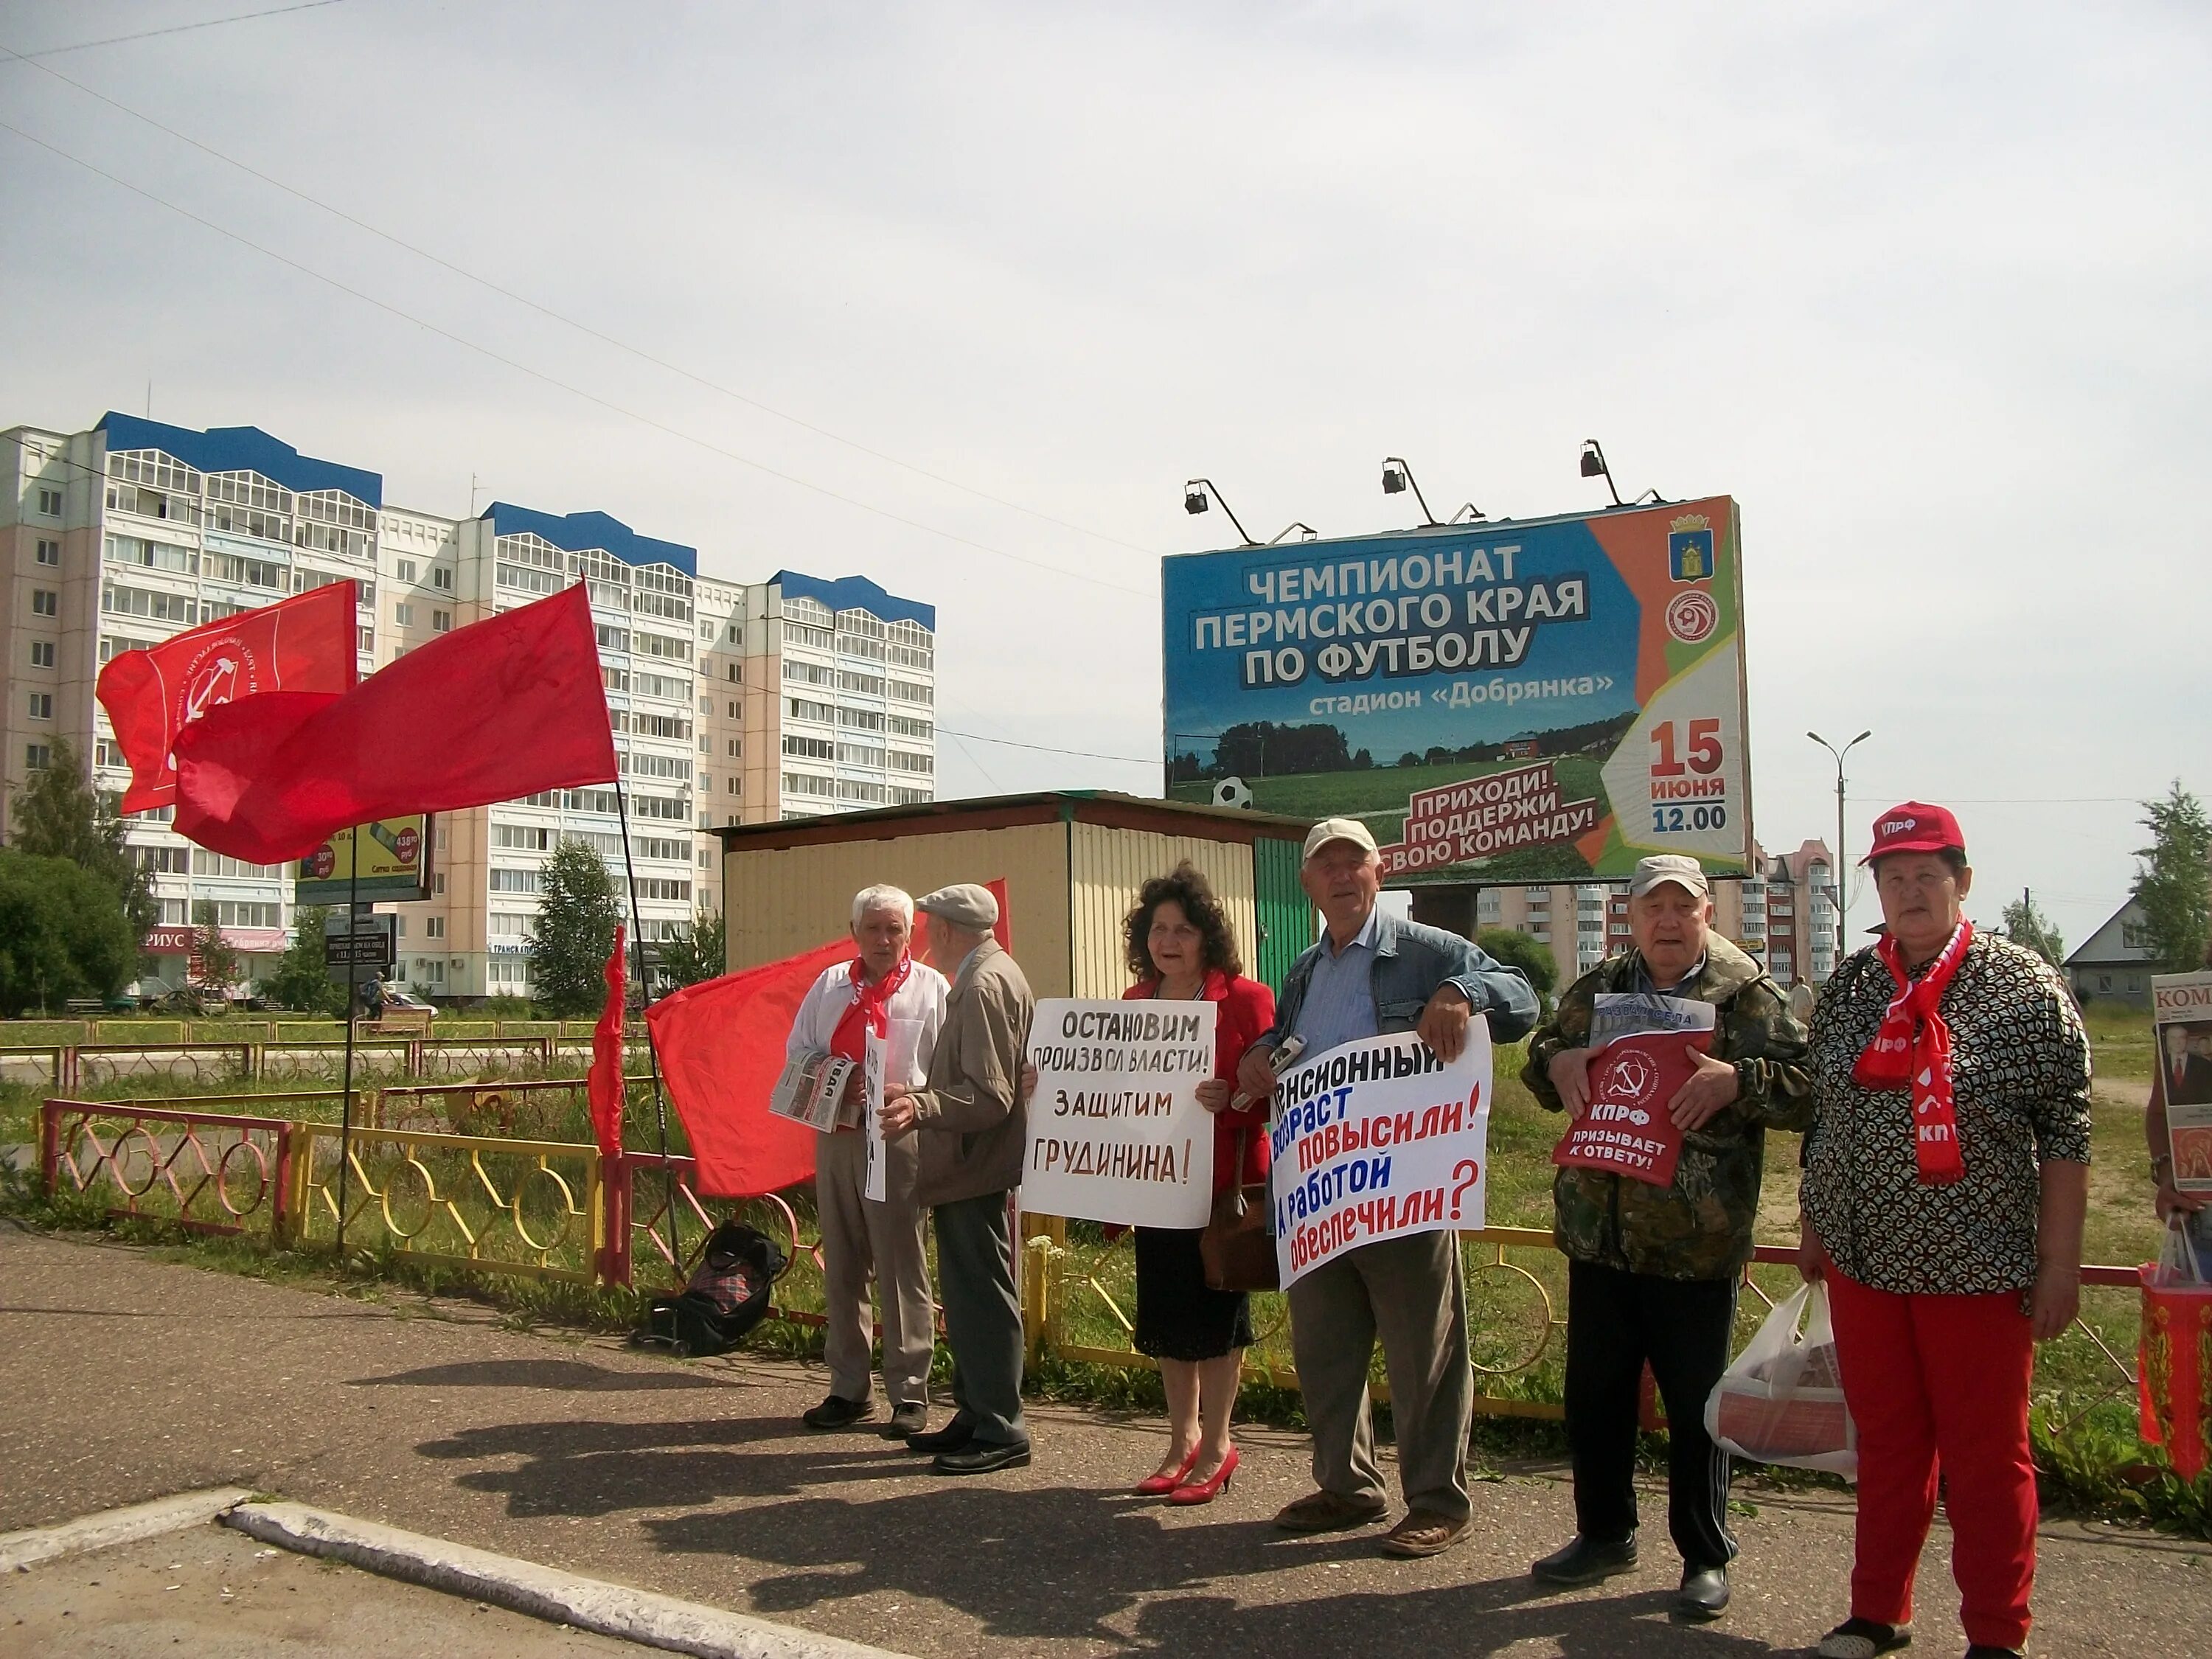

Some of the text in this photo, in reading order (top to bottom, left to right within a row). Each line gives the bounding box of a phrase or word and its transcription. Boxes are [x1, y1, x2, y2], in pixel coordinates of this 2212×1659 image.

[1250, 545, 1521, 604] ЧЕМПИОНАТ
[1196, 580, 1584, 650] ПЕРМСКОГО КРАЯ
[1246, 627, 1530, 684] ПО ФУТБОЛУ
[1310, 676, 1613, 716] стадион «Добрянка»
[1651, 718, 1723, 776] 15
[1417, 769, 1548, 818] ПРИХОДИ!
[1411, 791, 1556, 844] ПОДДЕРЖИ
[1652, 805, 1726, 832] 12.00
[1382, 807, 1593, 873] СВОЮ КОМАНДУ!
[1062, 1011, 1200, 1042] ОСТАНОВИМ
[1654, 1009, 1692, 1026] СЕЛА
[1034, 1045, 1209, 1074] ПРОИЗВОЛ ВЛАСТИ!
[1054, 1089, 1172, 1119] ЗАЩИТИМ
[1590, 1105, 1650, 1126] КПРФ
[1034, 1138, 1192, 1185] ГРУДИНИНА!
[1572, 1130, 1666, 1156] ПРИЗЫВАЕТ
[1584, 1145, 1653, 1170] ОТВЕТУ!
